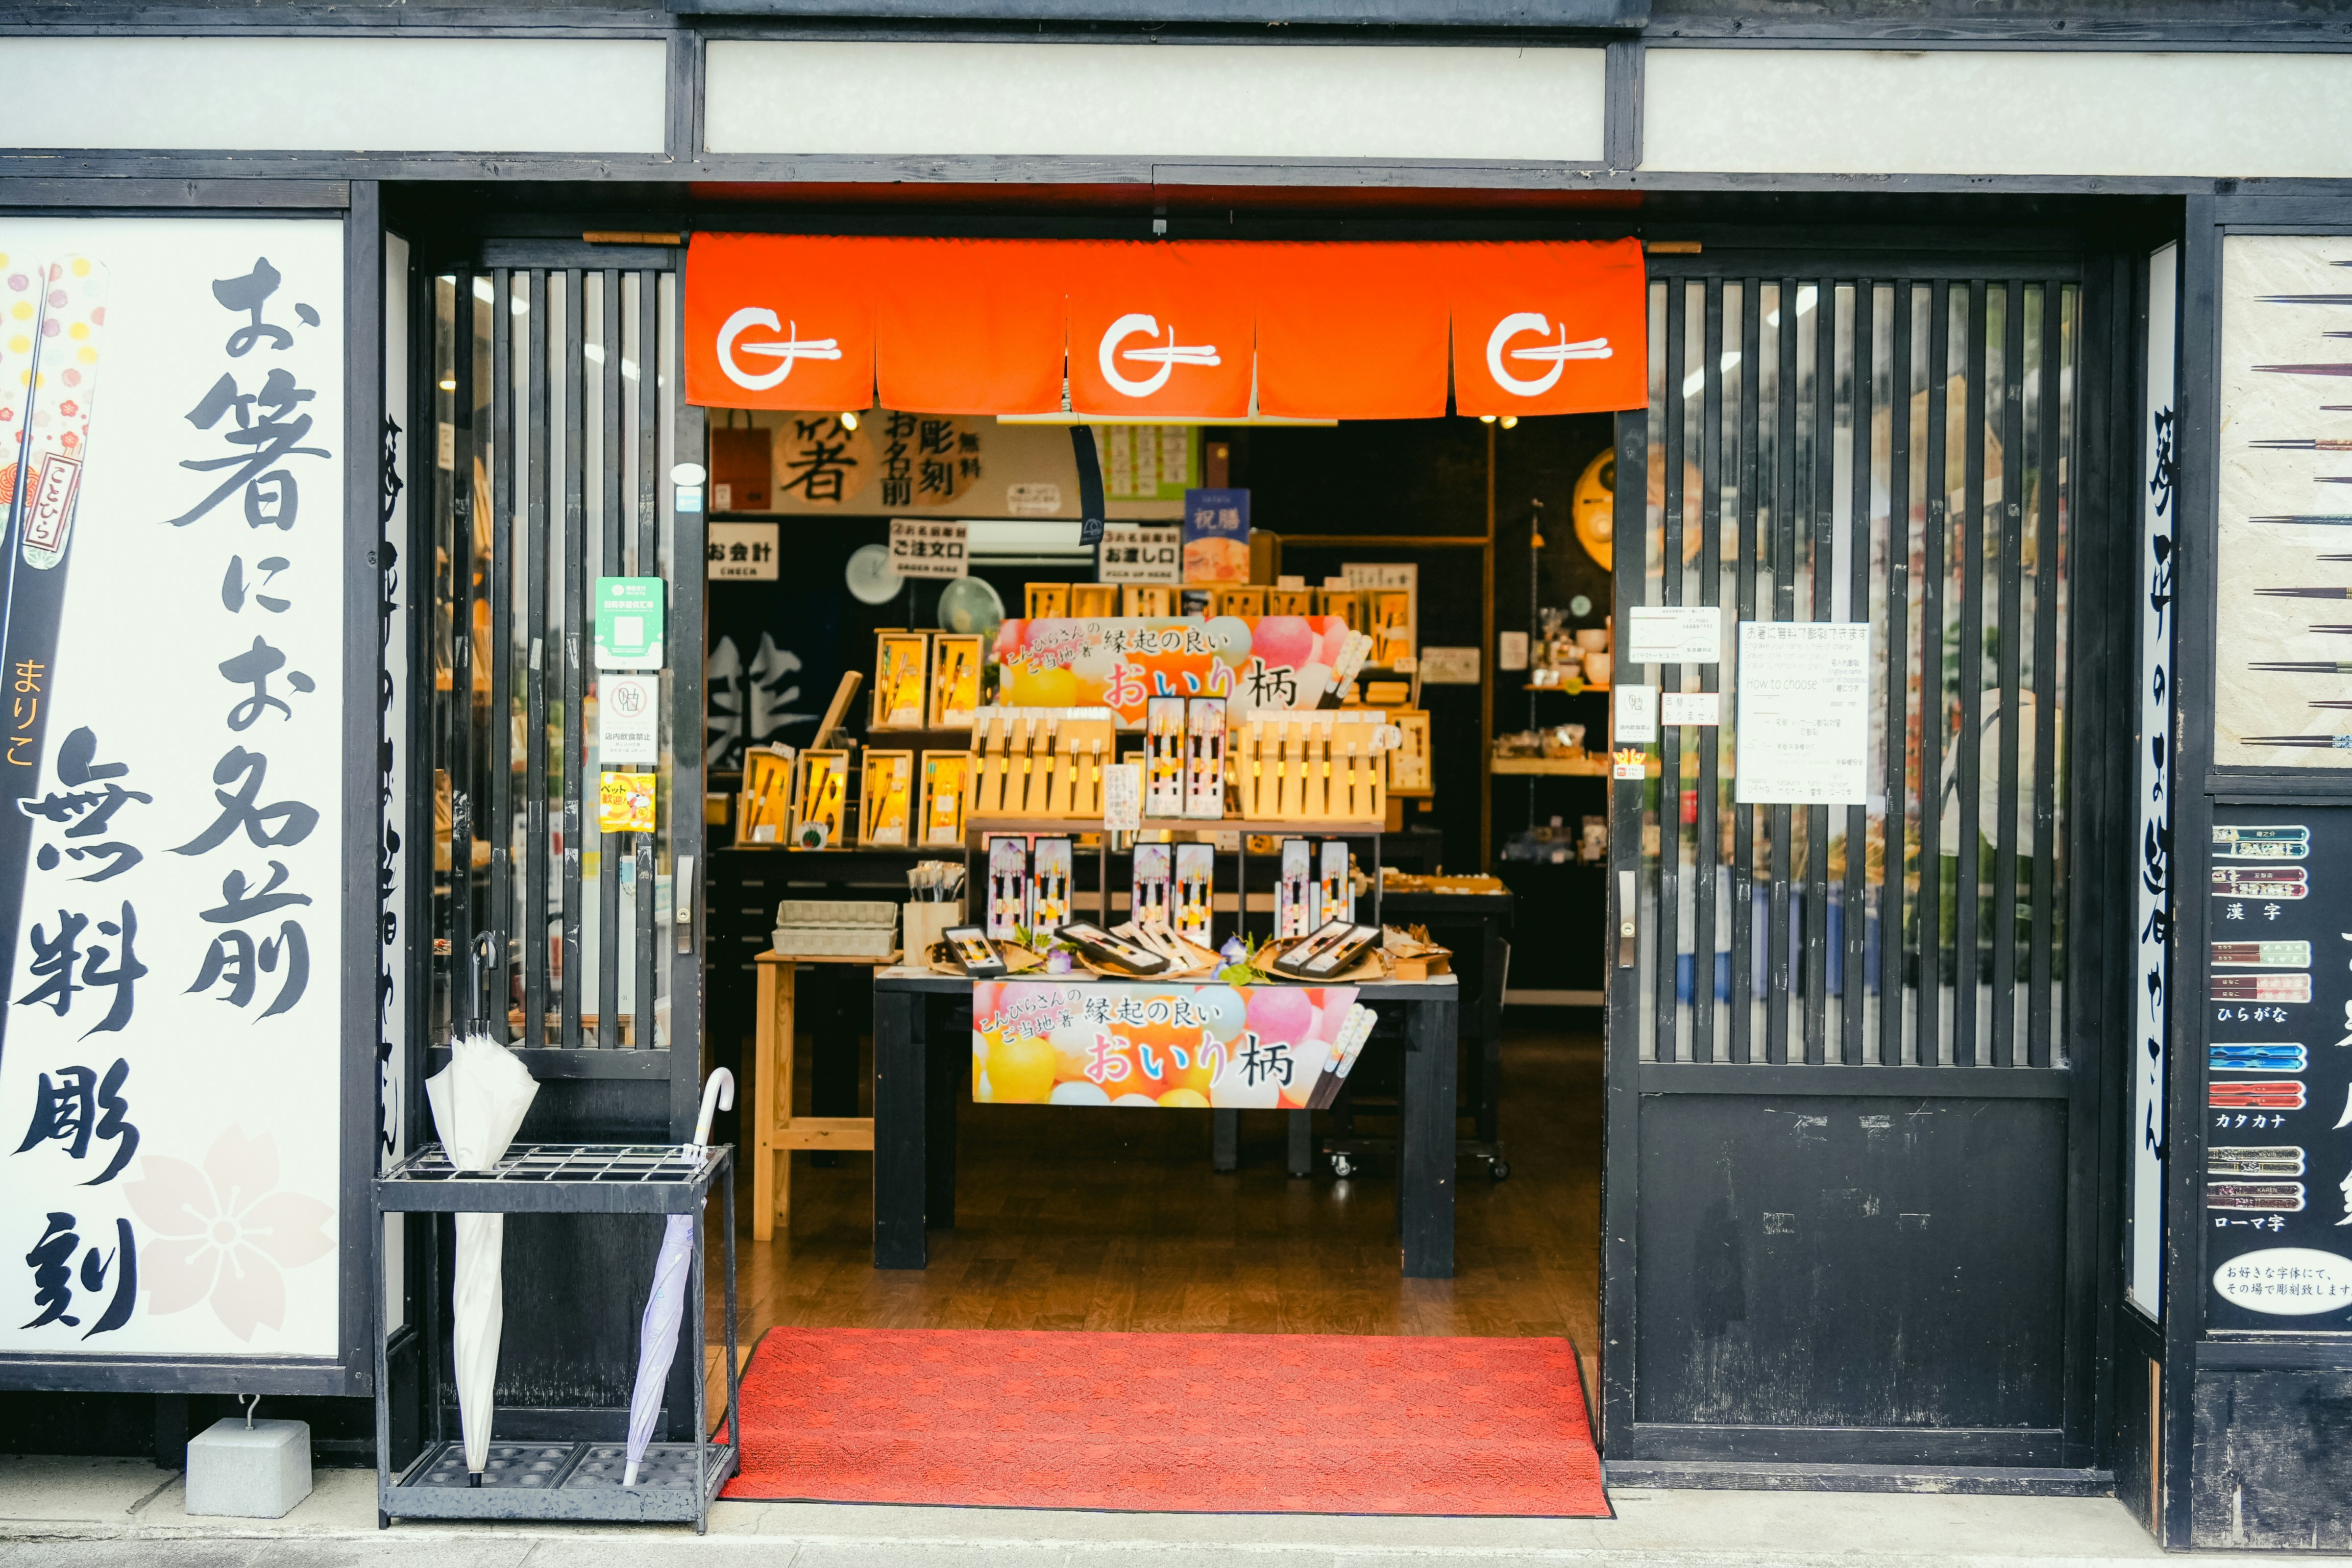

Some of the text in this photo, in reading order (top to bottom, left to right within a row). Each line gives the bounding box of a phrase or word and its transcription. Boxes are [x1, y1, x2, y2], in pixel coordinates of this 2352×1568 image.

[36, 466, 65, 540] ことひら
[894, 539, 963, 559] ご注文口
[158, 257, 331, 1024] お箸にお名前
[1103, 628, 1229, 654] 縁起の良い
[1747, 626, 1867, 641] お箸に無料で彫刻できます
[1007, 621, 1100, 665] こんぴらさんの
[1745, 641, 1769, 651] Engrave
[1832, 642, 1852, 652] charge
[1027, 642, 1093, 674] ご当地箸
[1828, 668, 1848, 676] Engrave
[1747, 675, 1818, 690] How to choose
[1665, 697, 1705, 707] 両替して
[7, 659, 45, 766] まりこ
[1665, 712, 1716, 722] おりません
[605, 732, 651, 741] 店内飲食禁止
[600, 785, 626, 794] ペット
[2226, 902, 2282, 921] 漢字
[978, 987, 1082, 1034] こんぴらさんの
[1085, 997, 1221, 1027] 縁起の良い
[2218, 1007, 2288, 1022] ひらがな
[10, 726, 153, 1341] 無料彫刻
[1002, 1008, 1074, 1043] ご当地箸
[1086, 1032, 1294, 1088] おいり柄
[2216, 1113, 2287, 1129] カタカナ
[2215, 1214, 2286, 1232] ローマ字
[2226, 1266, 2331, 1280] お好きな字体にて、
[2227, 1283, 2352, 1295] その場で彫刻致します
